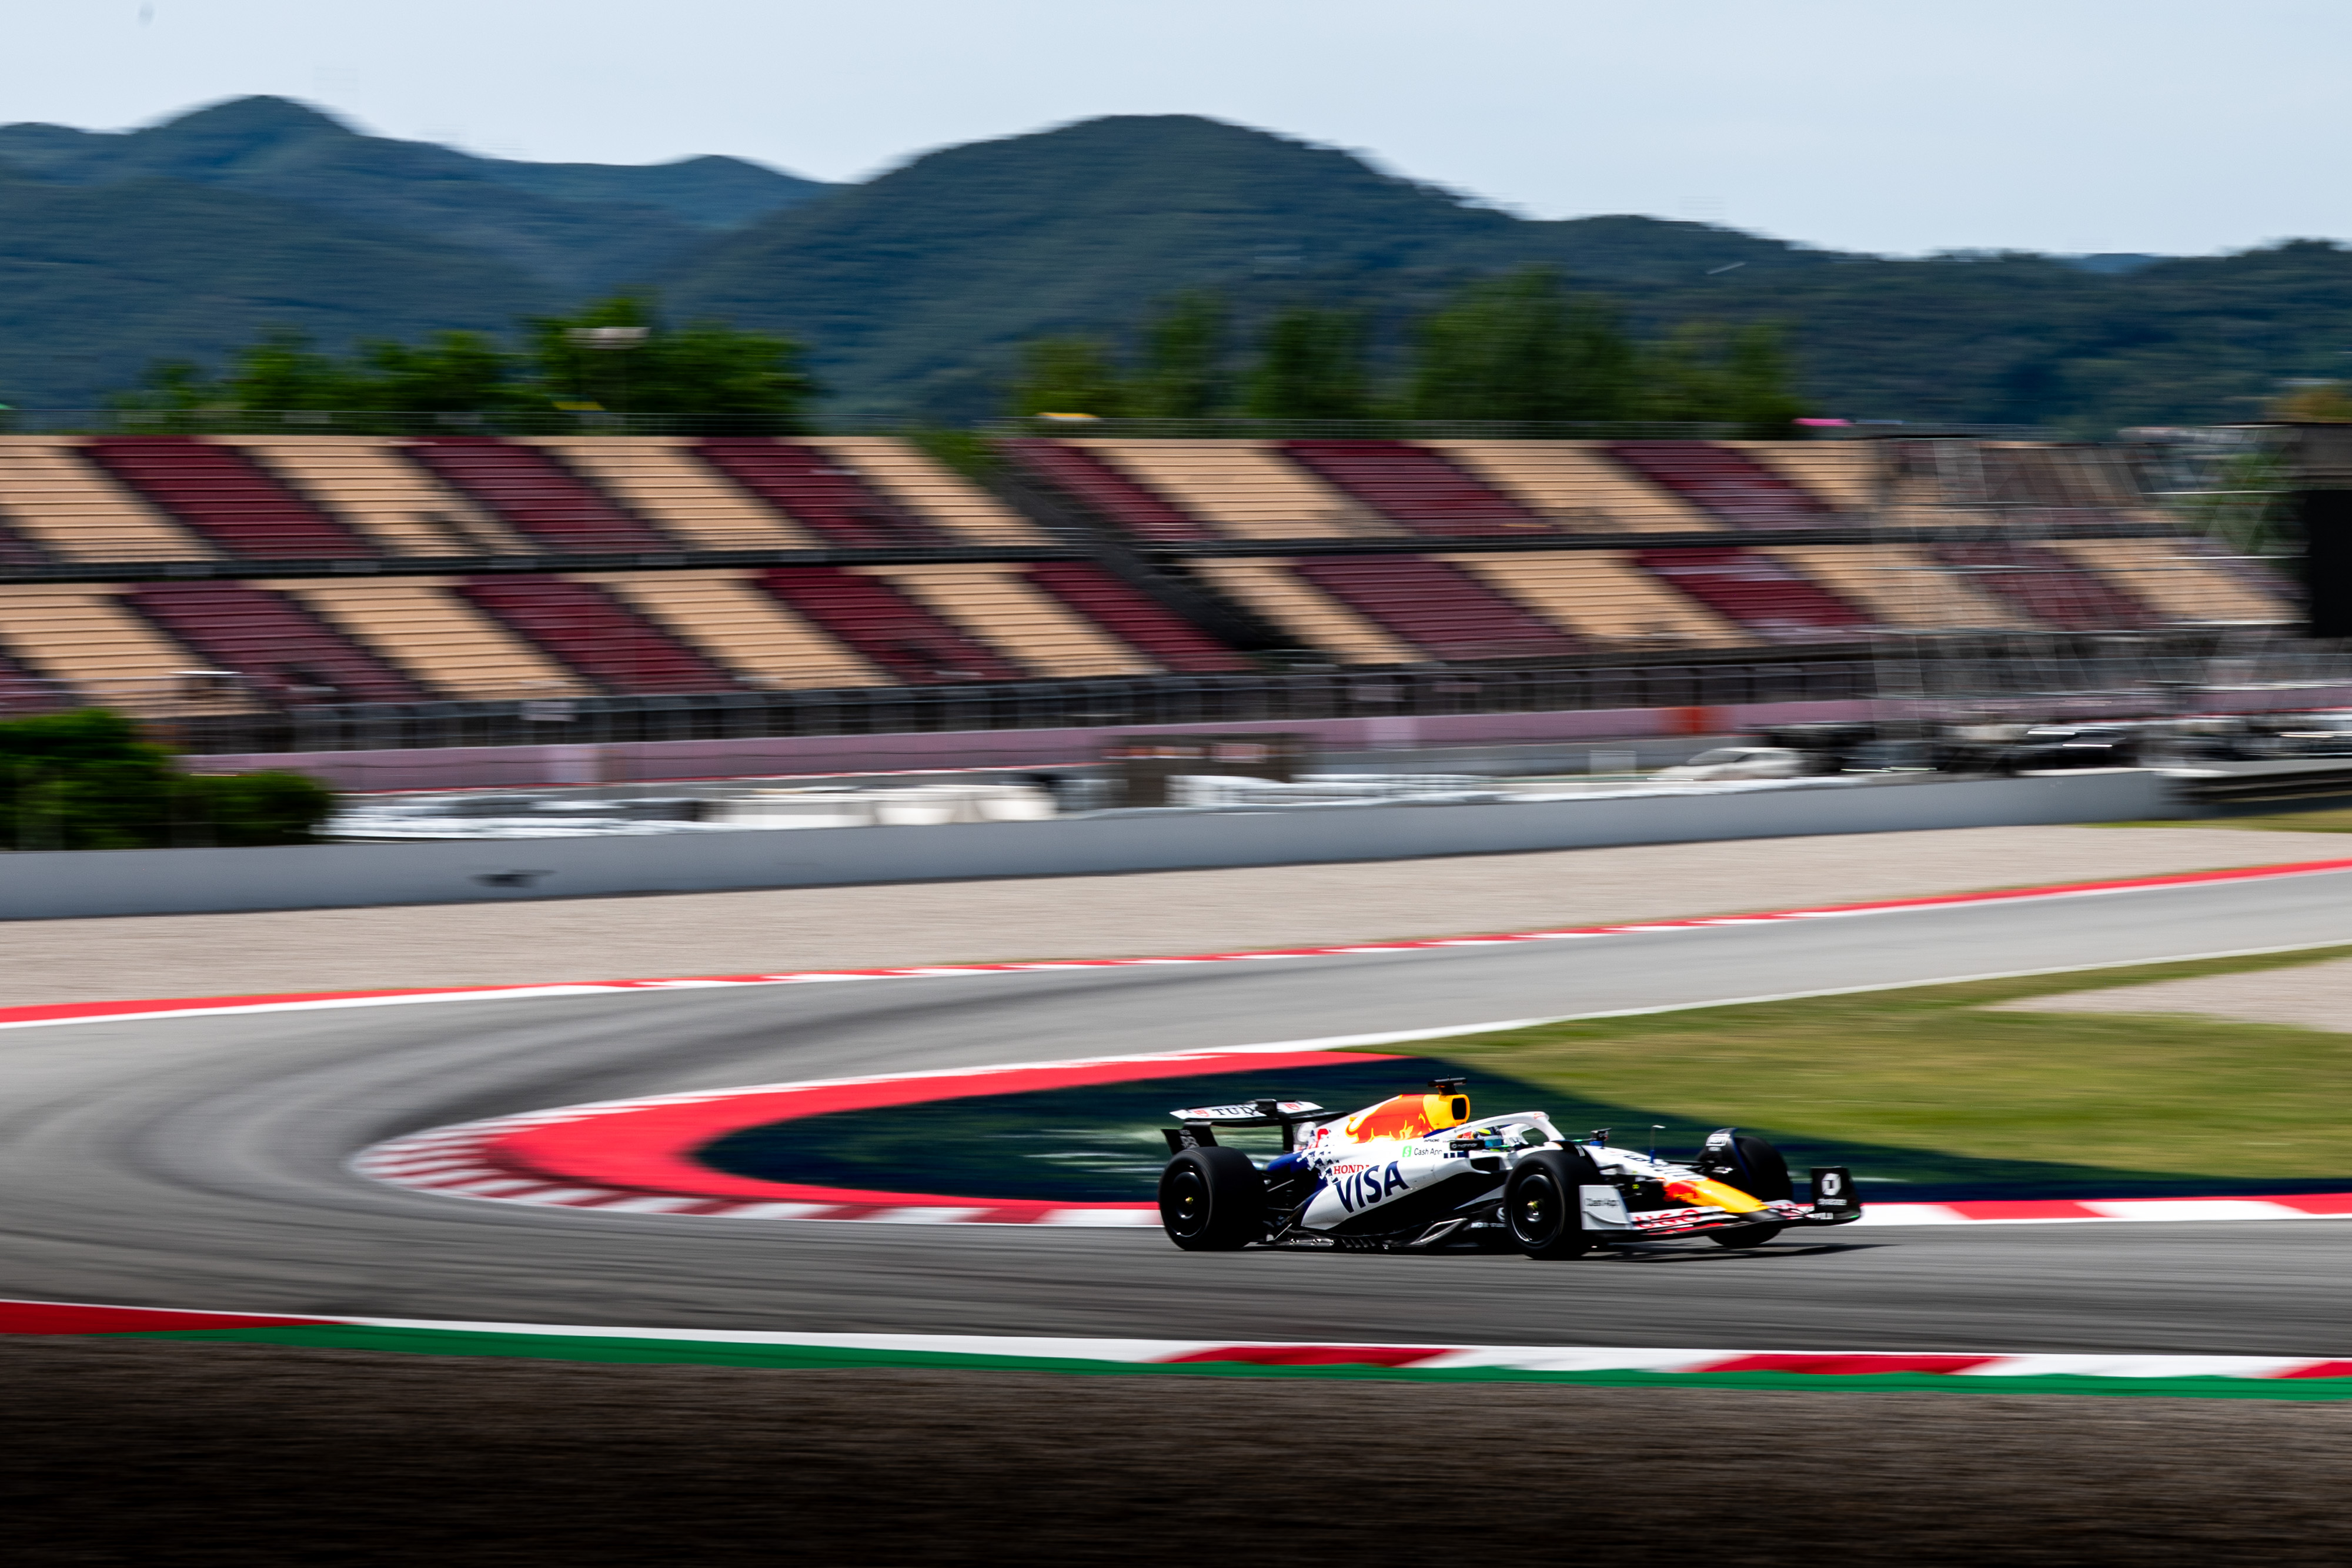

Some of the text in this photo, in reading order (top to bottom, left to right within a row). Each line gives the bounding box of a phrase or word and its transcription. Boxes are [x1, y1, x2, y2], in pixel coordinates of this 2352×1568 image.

[1211, 1106, 1255, 1116] TUD
[1334, 1165, 1369, 1175] HOND
[1333, 1161, 1410, 1213] VISA
[1634, 1209, 1700, 1228] UGO
